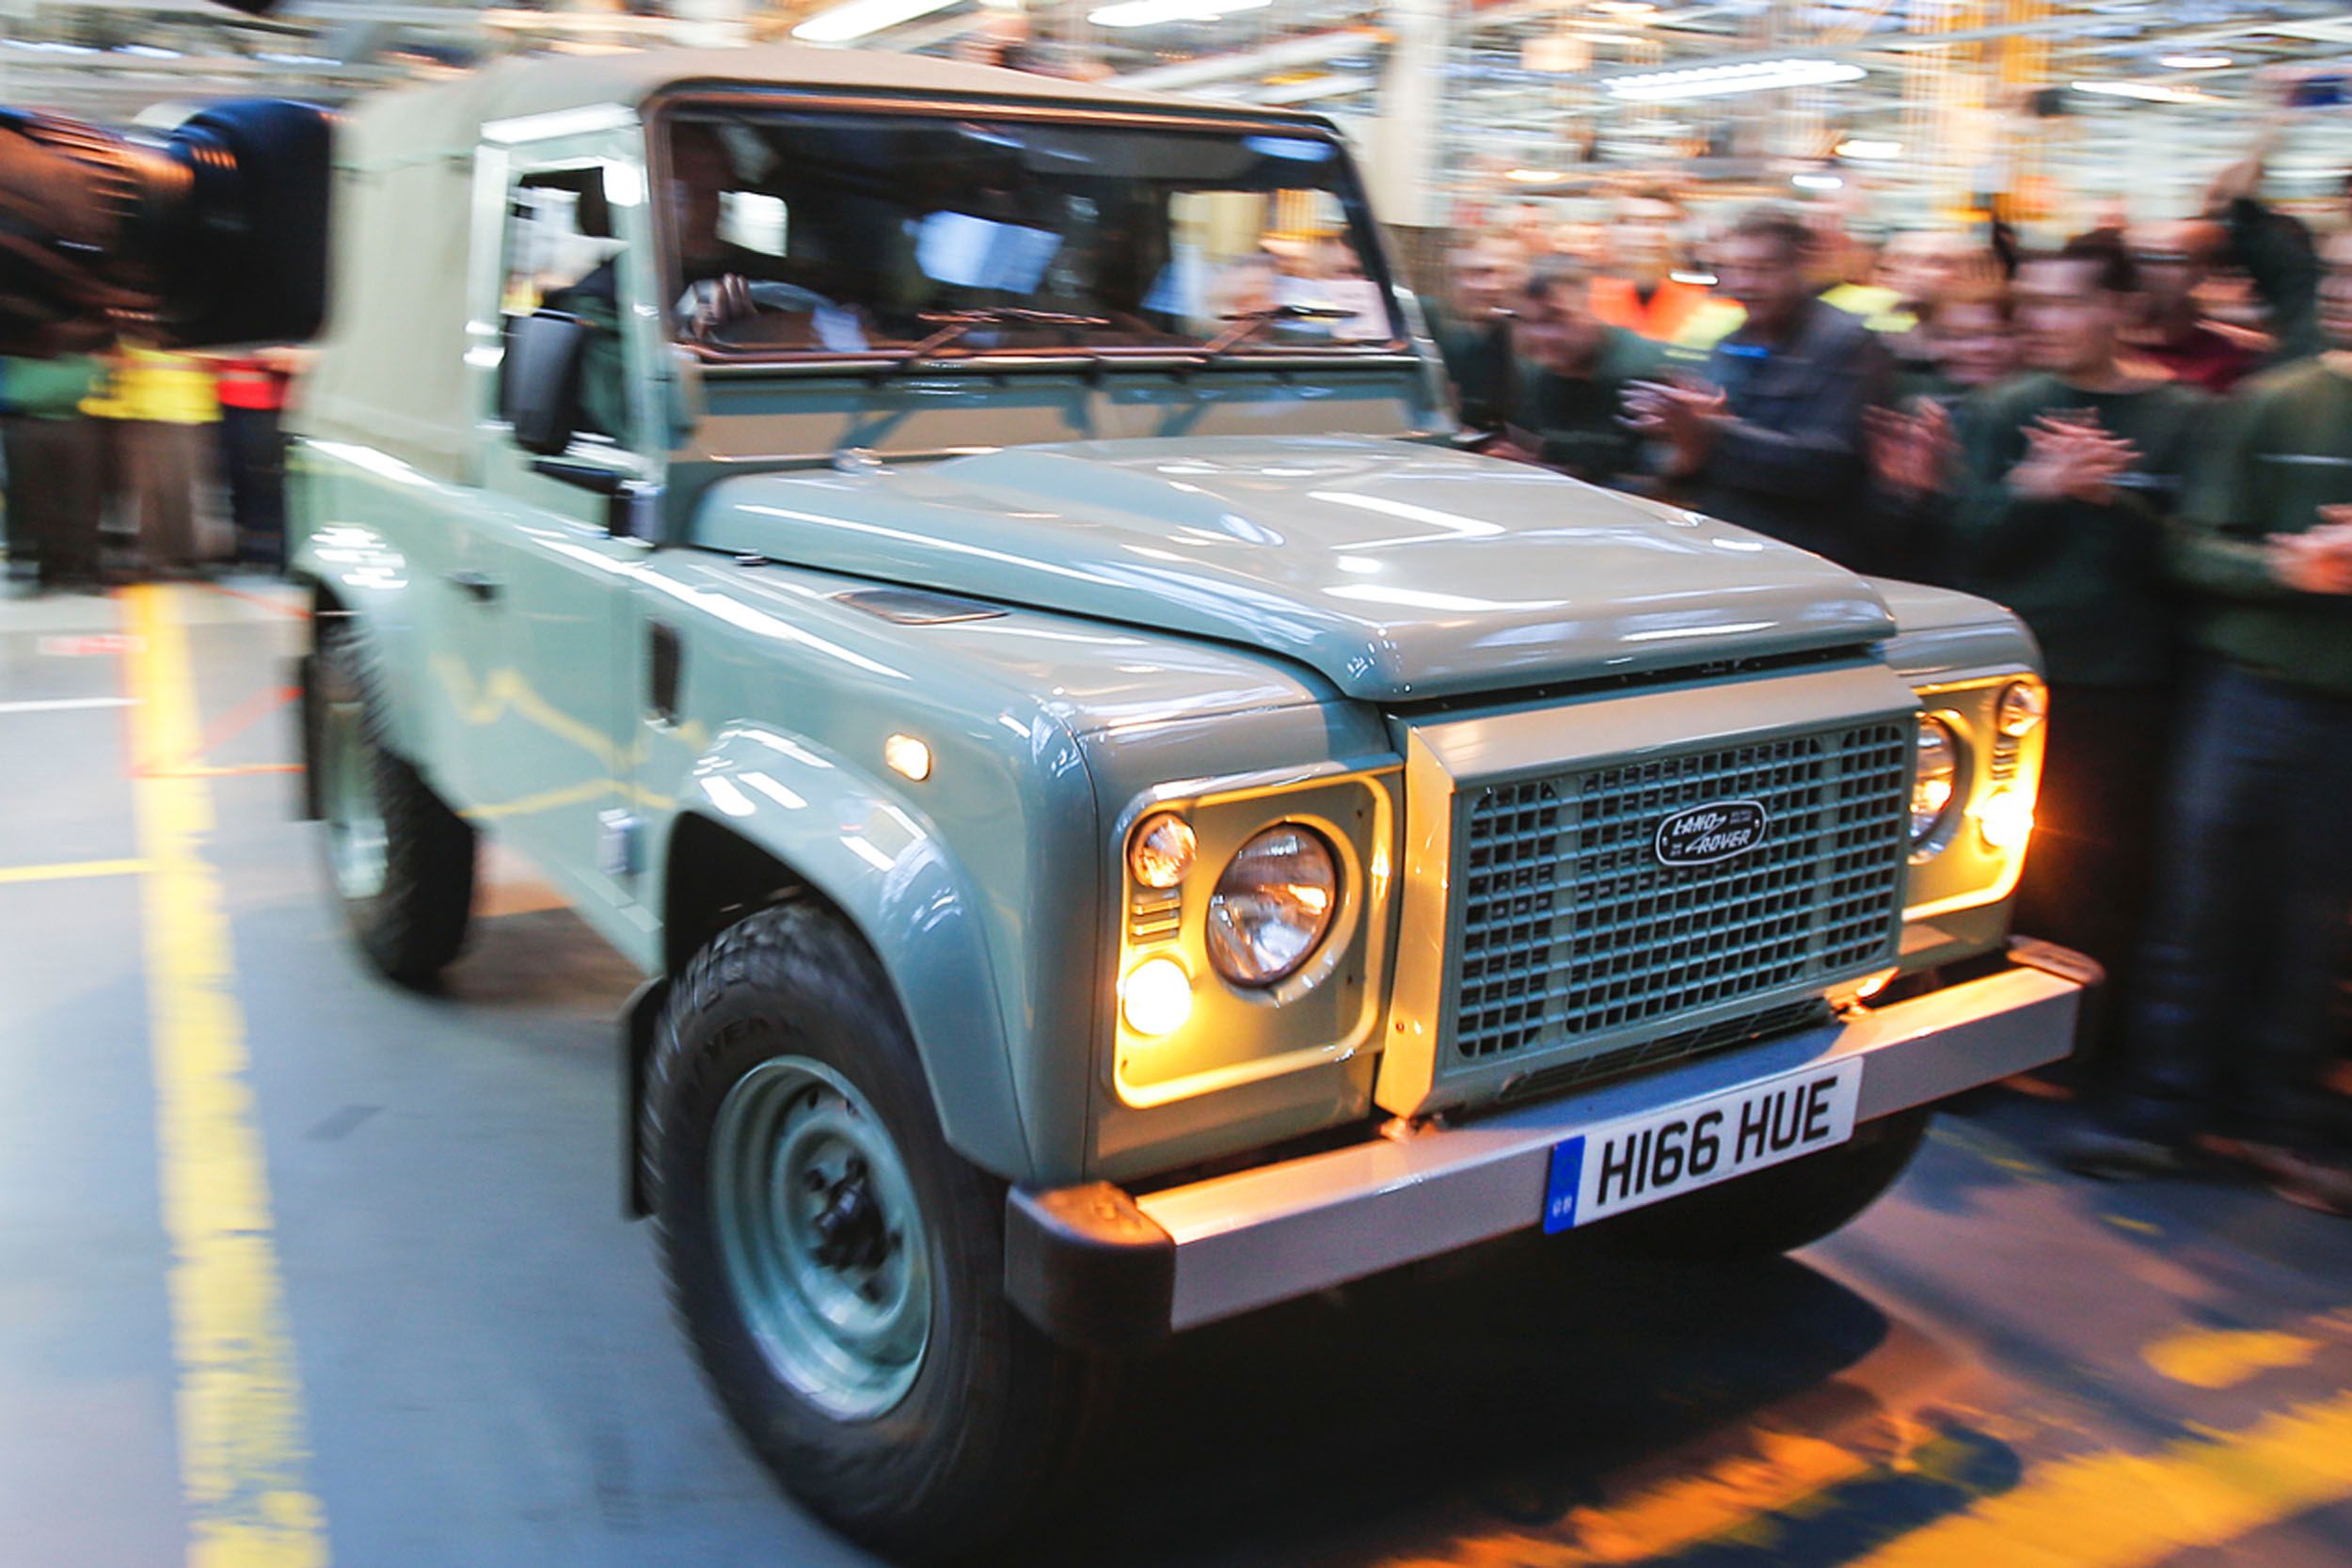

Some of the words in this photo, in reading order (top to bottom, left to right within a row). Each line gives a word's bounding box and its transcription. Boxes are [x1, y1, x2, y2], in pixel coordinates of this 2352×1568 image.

[1672, 813, 1717, 836] LAND
[1697, 828, 1751, 854] ROVER
[1735, 1076, 1837, 1164] HUE
